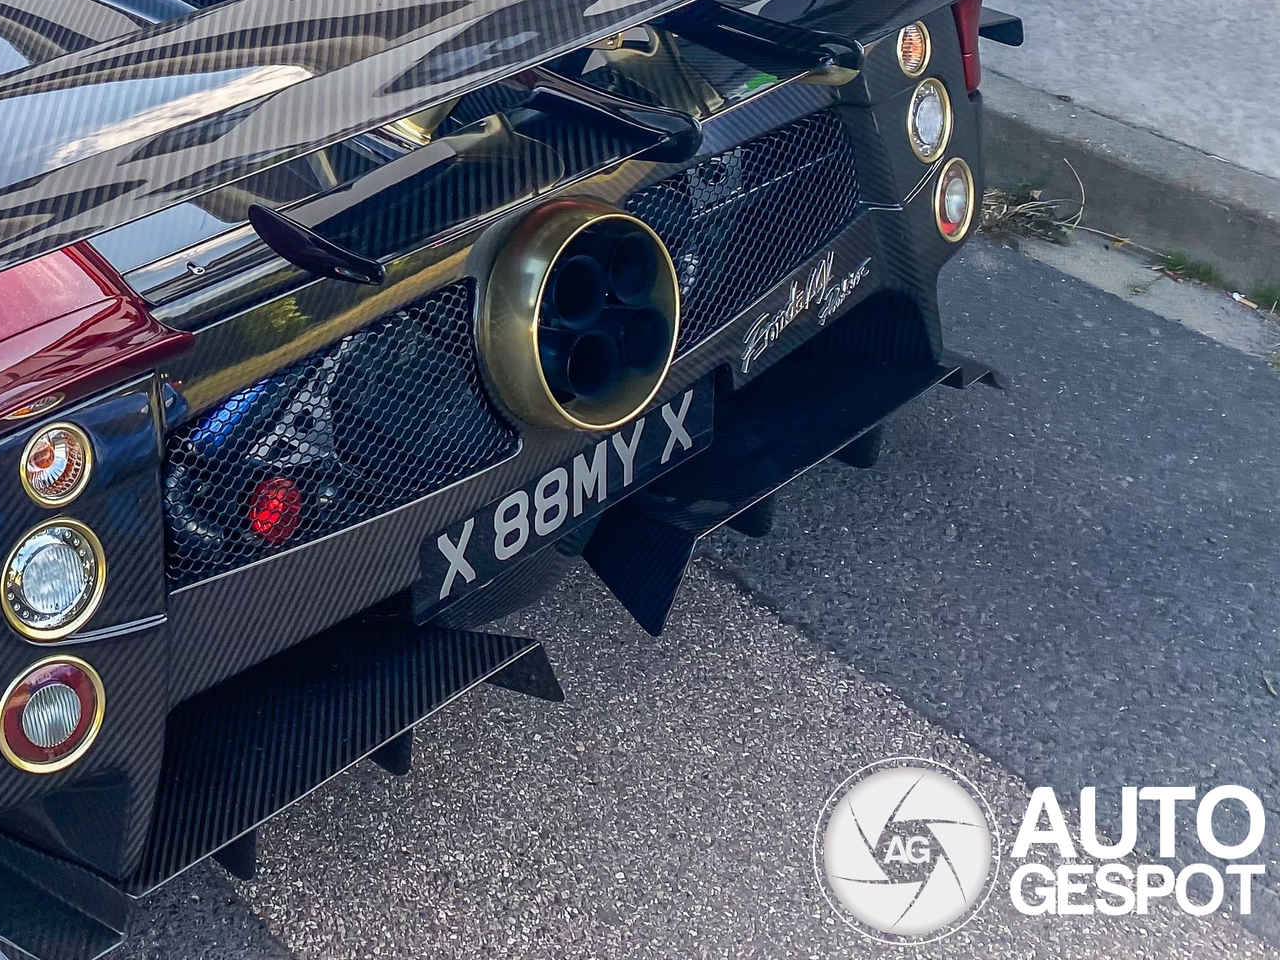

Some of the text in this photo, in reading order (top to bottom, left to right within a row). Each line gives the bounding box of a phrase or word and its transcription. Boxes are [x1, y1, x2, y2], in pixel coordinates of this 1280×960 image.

[437, 389, 694, 600] X 88MY X
